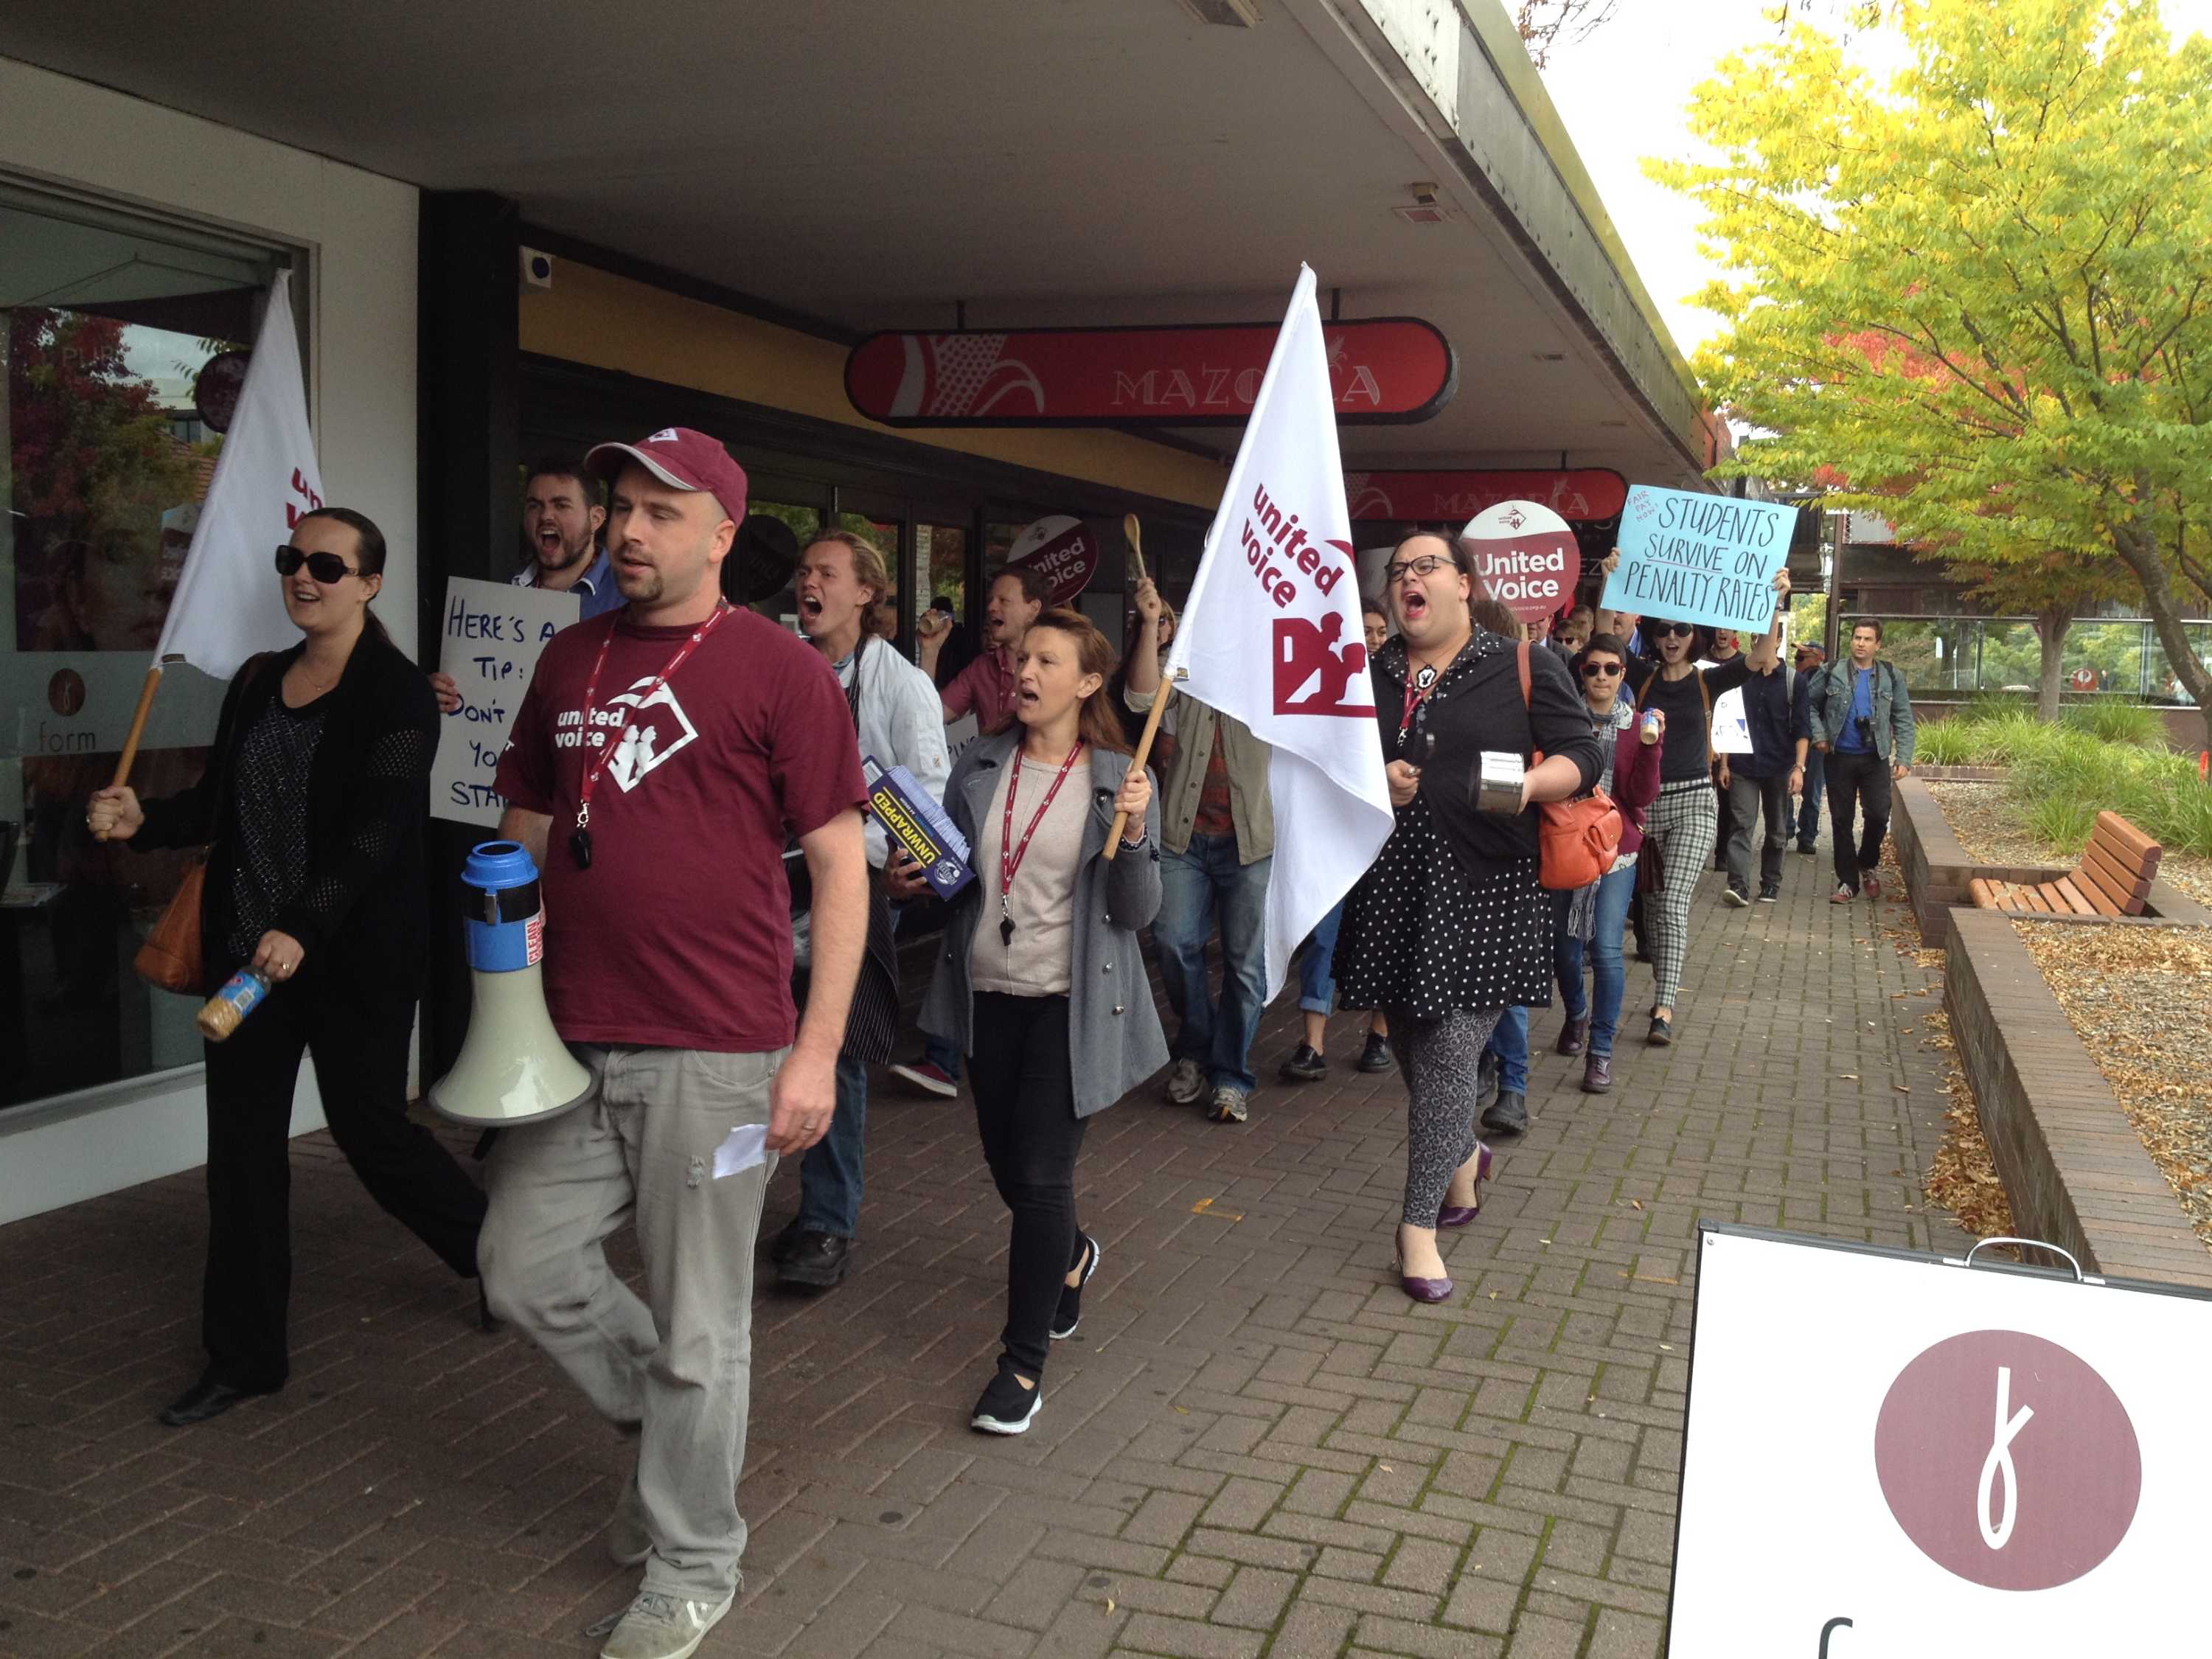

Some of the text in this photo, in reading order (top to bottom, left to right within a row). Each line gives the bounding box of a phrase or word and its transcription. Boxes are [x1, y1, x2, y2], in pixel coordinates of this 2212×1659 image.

[1111, 362, 1381, 408] MAZOA
[1627, 490, 1650, 507] FAIR
[1253, 483, 1345, 597] united
[1659, 497, 1779, 547] STUDENTS
[1028, 537, 1085, 573] nited
[1048, 560, 1085, 588] oice
[1241, 518, 1296, 608] voice
[1474, 548, 1564, 576] United
[1645, 533, 1728, 571] SURVIVE
[1735, 552, 1767, 579] ON
[1483, 576, 1559, 601] Voice
[1624, 561, 1774, 622] PENALTY RATES
[448, 595, 555, 642] HERE'S A
[473, 657, 523, 681] TIP:
[40, 721, 96, 752] form
[469, 740, 498, 768] YO
[874, 792, 936, 864] UNWRAPPED
